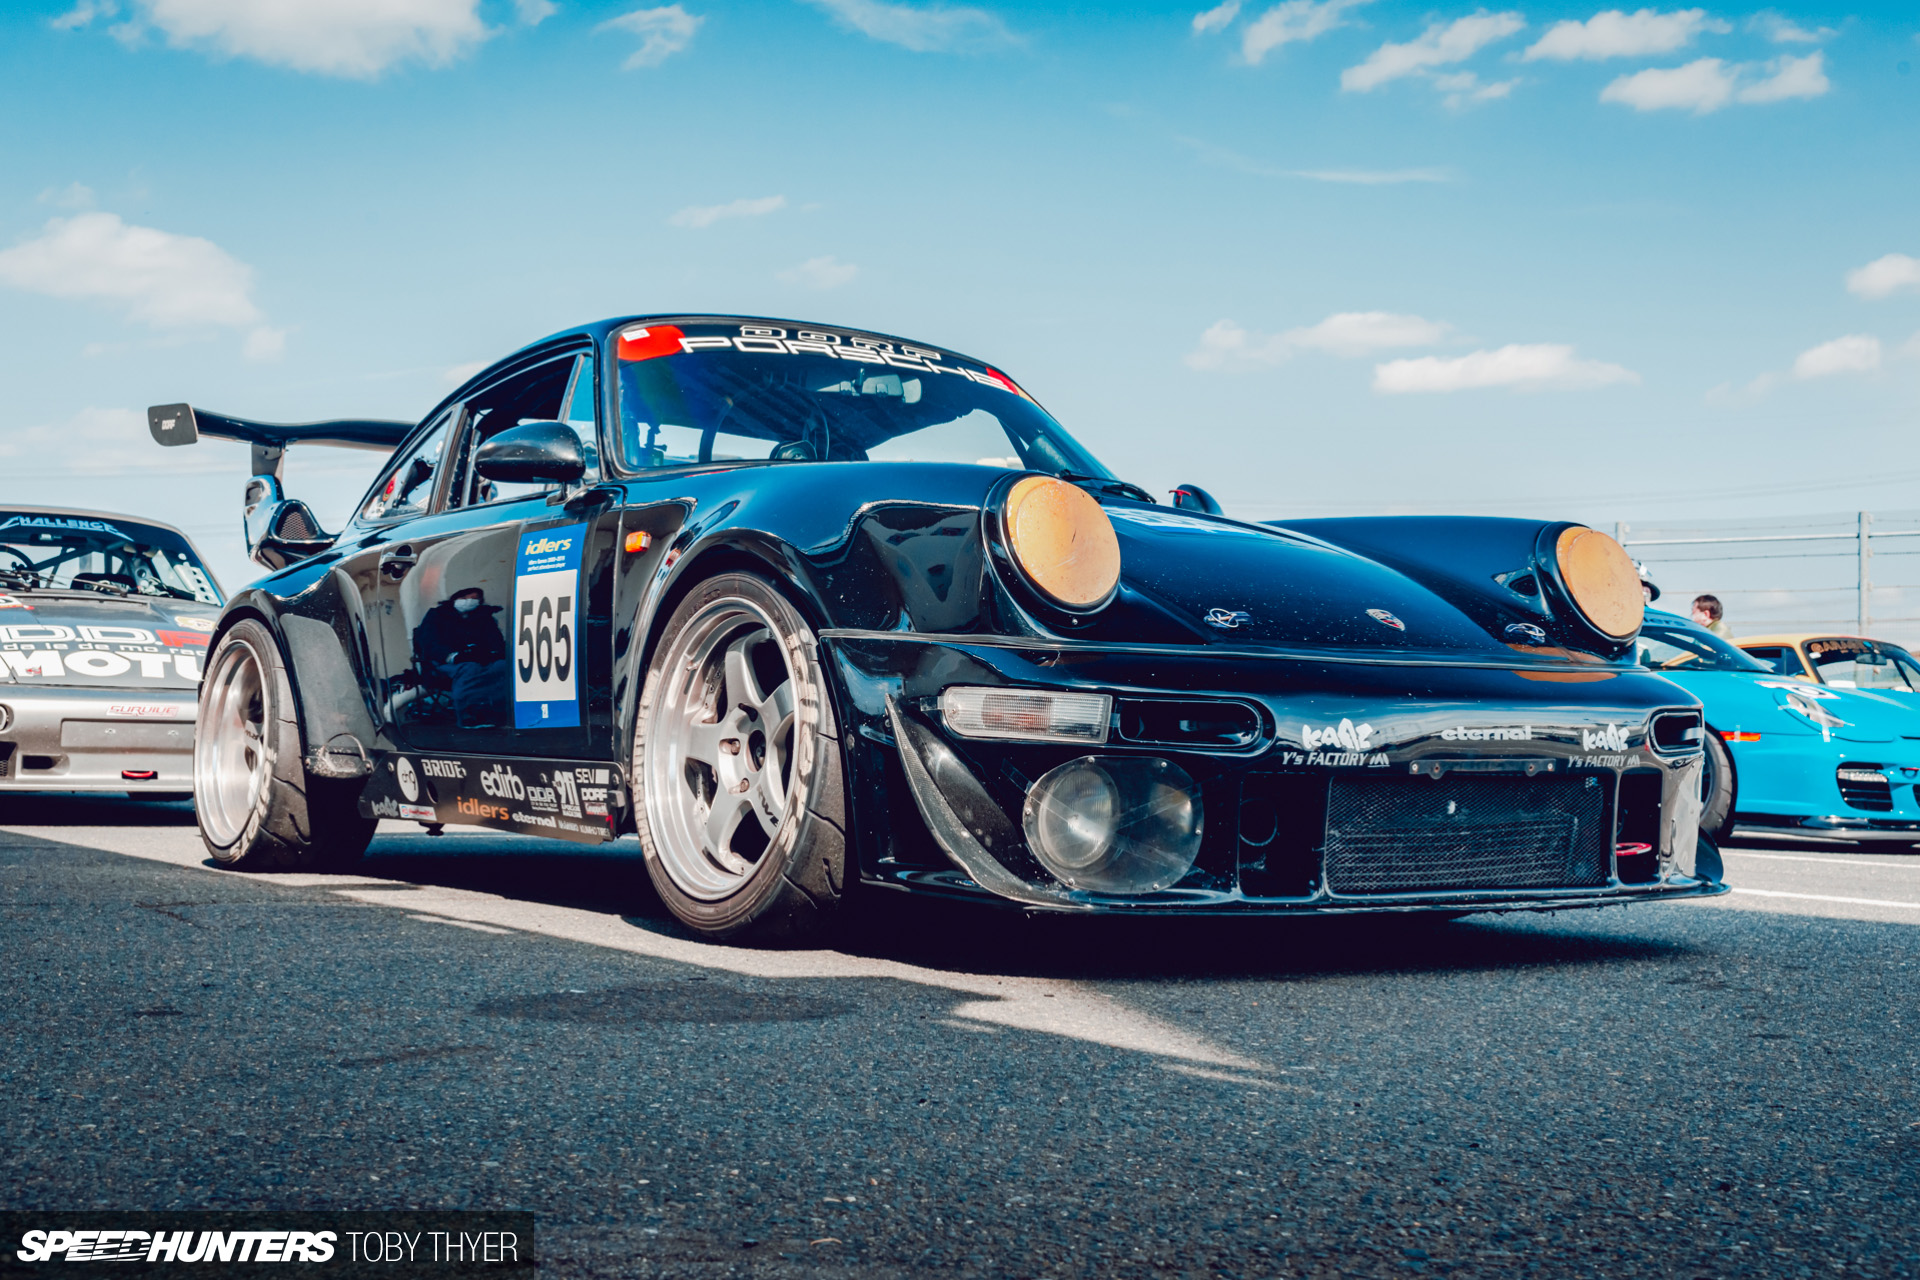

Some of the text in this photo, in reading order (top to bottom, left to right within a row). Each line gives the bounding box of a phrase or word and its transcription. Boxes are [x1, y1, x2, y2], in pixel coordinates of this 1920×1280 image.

[678, 336, 1017, 395] PORSCHE
[525, 537, 572, 556] idlers
[518, 596, 571, 684] 565
[1440, 725, 1534, 741] eternal
[421, 759, 465, 779] BRIDE
[1306, 752, 1369, 767] FACTORY
[1584, 754, 1628, 768] FACTORY
[457, 796, 510, 820] idlers
[512, 811, 557, 828] eternal
